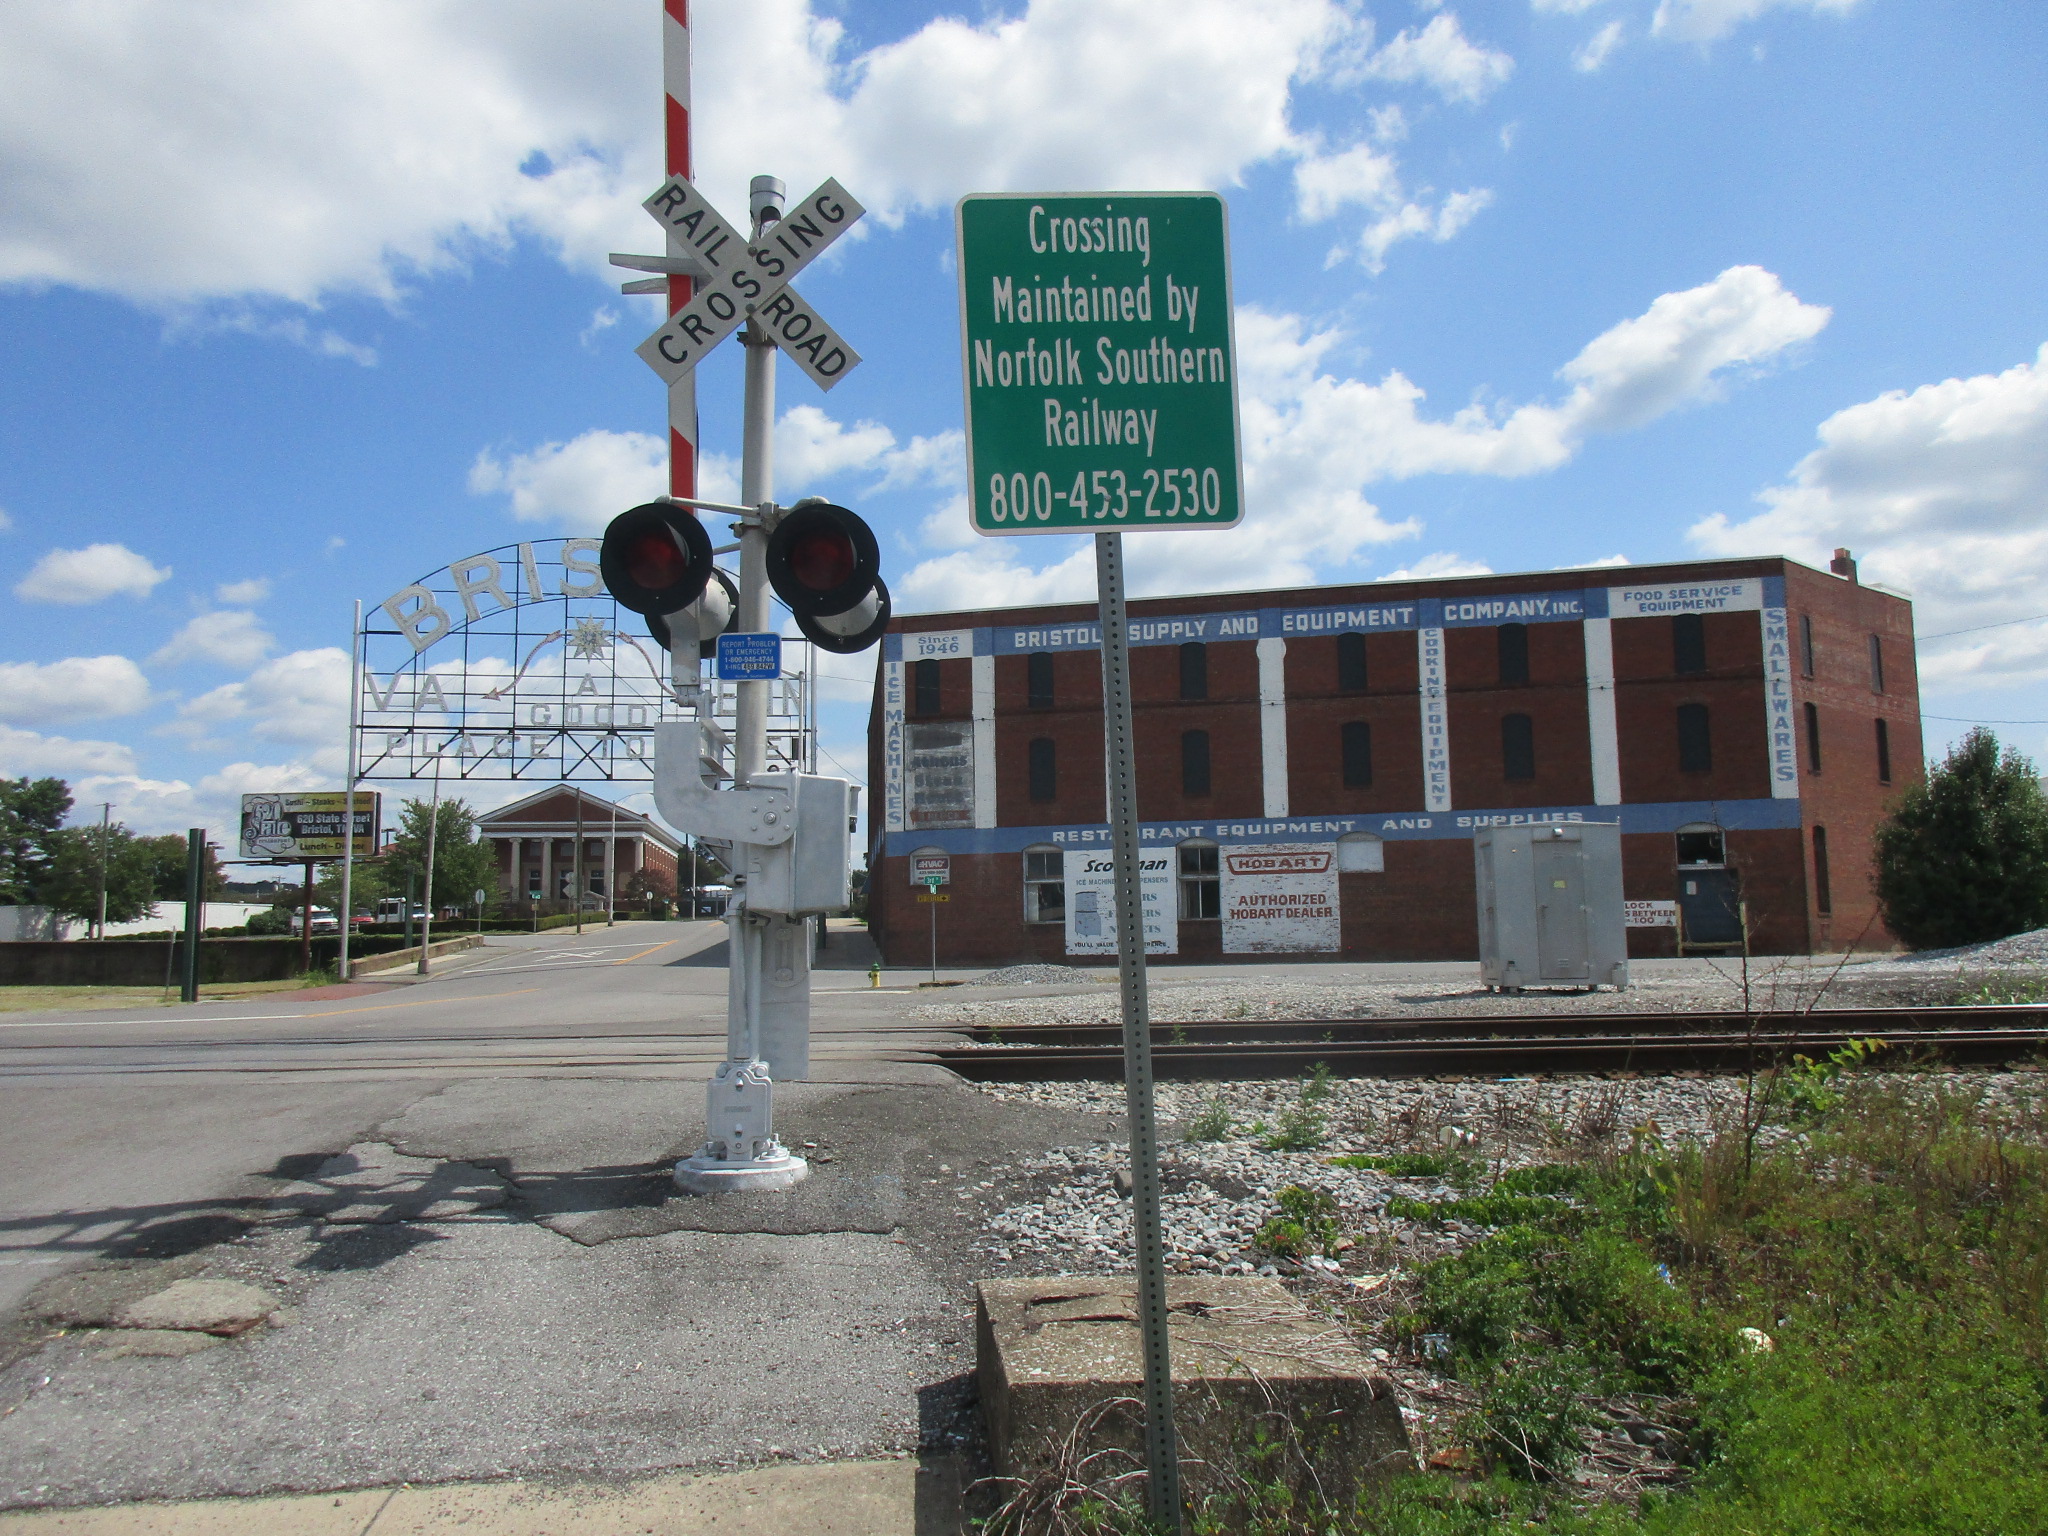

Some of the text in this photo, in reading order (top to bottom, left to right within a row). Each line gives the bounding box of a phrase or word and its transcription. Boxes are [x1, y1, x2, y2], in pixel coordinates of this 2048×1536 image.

[1029, 204, 1151, 267] Crossing
[653, 184, 846, 377] RAIL ROAD
[658, 196, 845, 364] CROSSING
[992, 273, 1199, 333] Maintained by
[974, 336, 1225, 387] Norfolk Southern
[1044, 397, 1157, 457] Railway
[990, 467, 1221, 522] 800-453-2530
[1624, 585, 1743, 602] FOOD SERVICE
[1639, 598, 1727, 613] EQUIPMENT
[1014, 627, 1102, 648] BRISTOL
[1129, 620, 1207, 641] SUPPLY
[1219, 616, 1259, 635] AND
[1282, 607, 1414, 632] EQUIPMENT
[1552, 601, 1584, 615] INC.
[736, 648, 773, 656] EMERGENCY
[747, 640, 776, 648] PROBLEM
[918, 635, 959, 645] Since
[918, 642, 959, 655] 1946
[365, 672, 450, 713] VA
[1766, 608, 1795, 782] SMALLWARES
[530, 703, 648, 727] GOOD
[1424, 628, 1446, 805] COOKING EQUIPMENT
[386, 732, 646, 760] PLACE TO
[885, 662, 903, 825] ICE MACHINES
[296, 812, 371, 824] 620 State Sreet
[1052, 811, 1583, 843] RESTRANT EQUIPMENT AND SUPPLIES
[299, 841, 365, 851] Lunch Diner
[1238, 857, 1321, 869] HOBART
[1230, 906, 1333, 920] HOBART DEALER
[1238, 893, 1327, 907] AUTHORIZED
